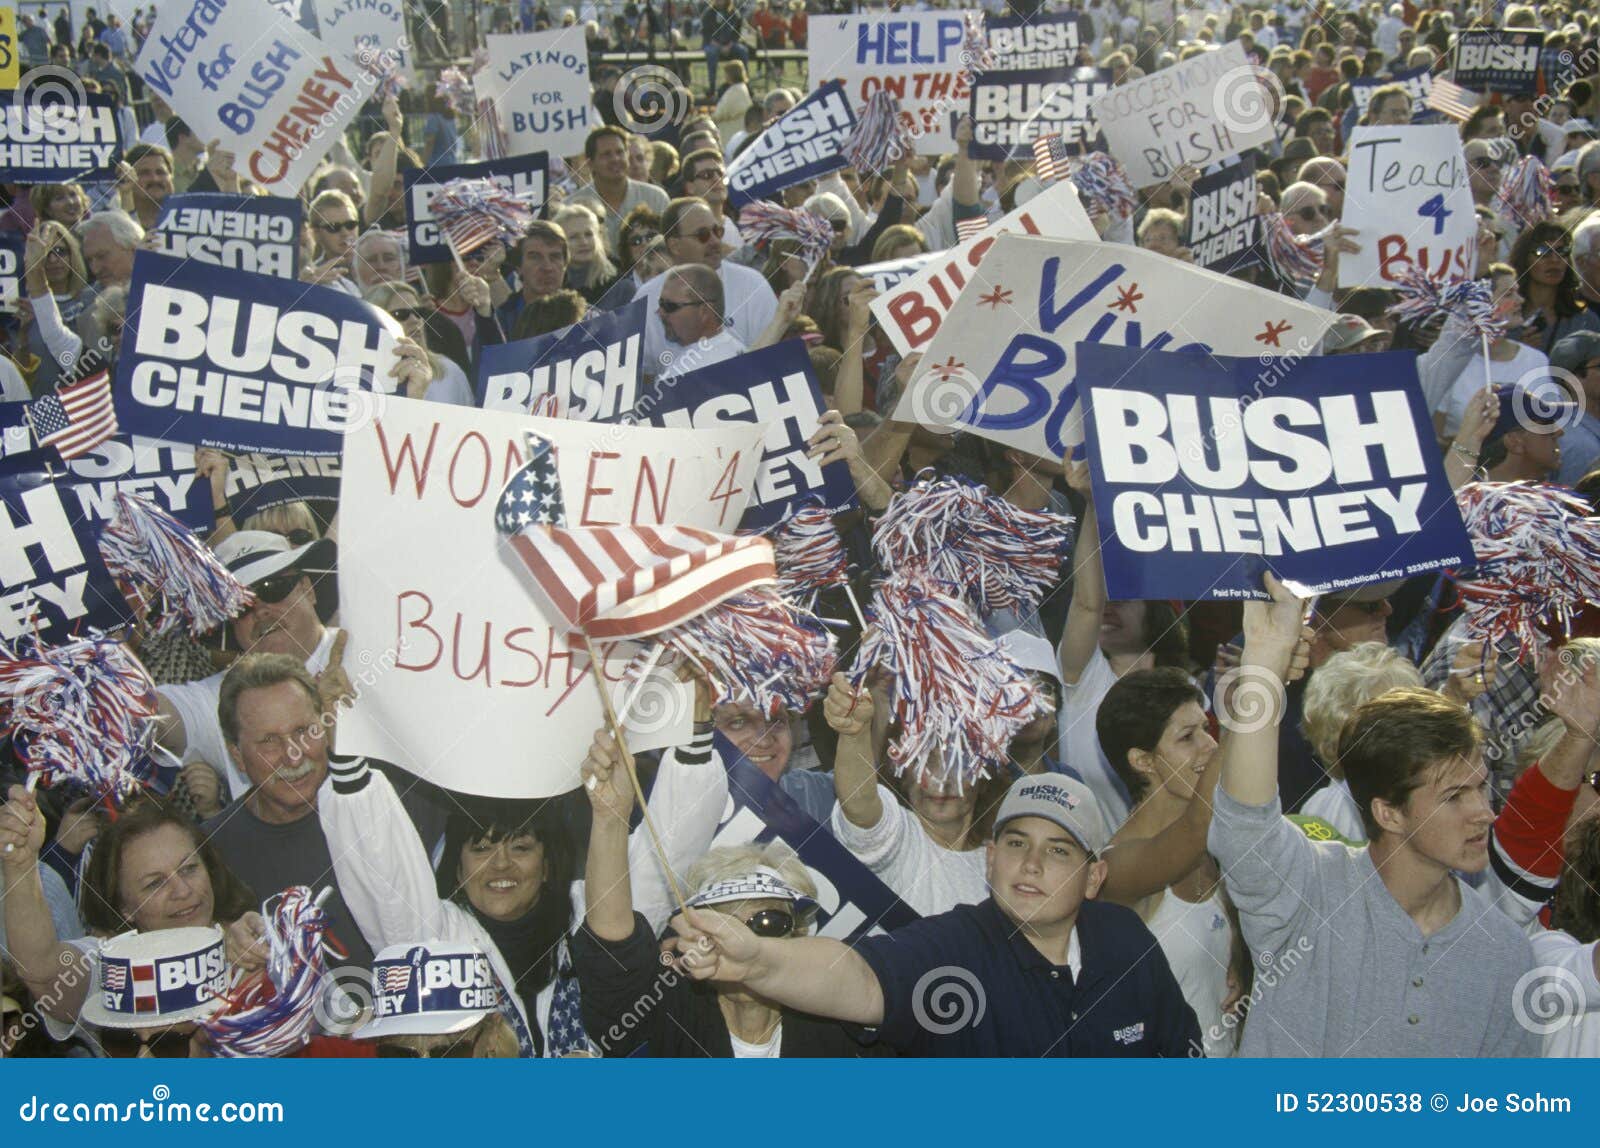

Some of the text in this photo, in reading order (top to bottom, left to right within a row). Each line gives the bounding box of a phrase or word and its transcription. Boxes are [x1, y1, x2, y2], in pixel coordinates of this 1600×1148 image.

[989, 22, 1079, 54] BUSH
[197, 43, 237, 92] for
[498, 50, 587, 82] LATINOS
[1458, 44, 1539, 73] BUSH
[217, 40, 302, 135] BUSH
[532, 92, 563, 105] FOR
[976, 82, 1108, 121] BUSH
[249, 56, 353, 184] CHENEY
[512, 106, 588, 134] BUSH
[975, 120, 1102, 146] CHENEY
[1148, 101, 1208, 138] FOR
[0, 144, 116, 168] HENEY
[1143, 120, 1235, 178] BUSH
[157, 207, 294, 243] CHENEY
[1190, 174, 1257, 243] BUSH
[1417, 193, 1454, 236] 4
[135, 284, 400, 394] BUSH
[131, 361, 350, 432] CHENE
[482, 333, 641, 422] BUSH
[1091, 387, 1427, 491] BUSH
[1112, 482, 1428, 556] CHENEY
[1212, 589, 1229, 598] Paid
[1332, 573, 1380, 589] Republican
[1380, 568, 1404, 581] Party
[195, 973, 226, 1003] CHE
[424, 957, 492, 989] BUS
